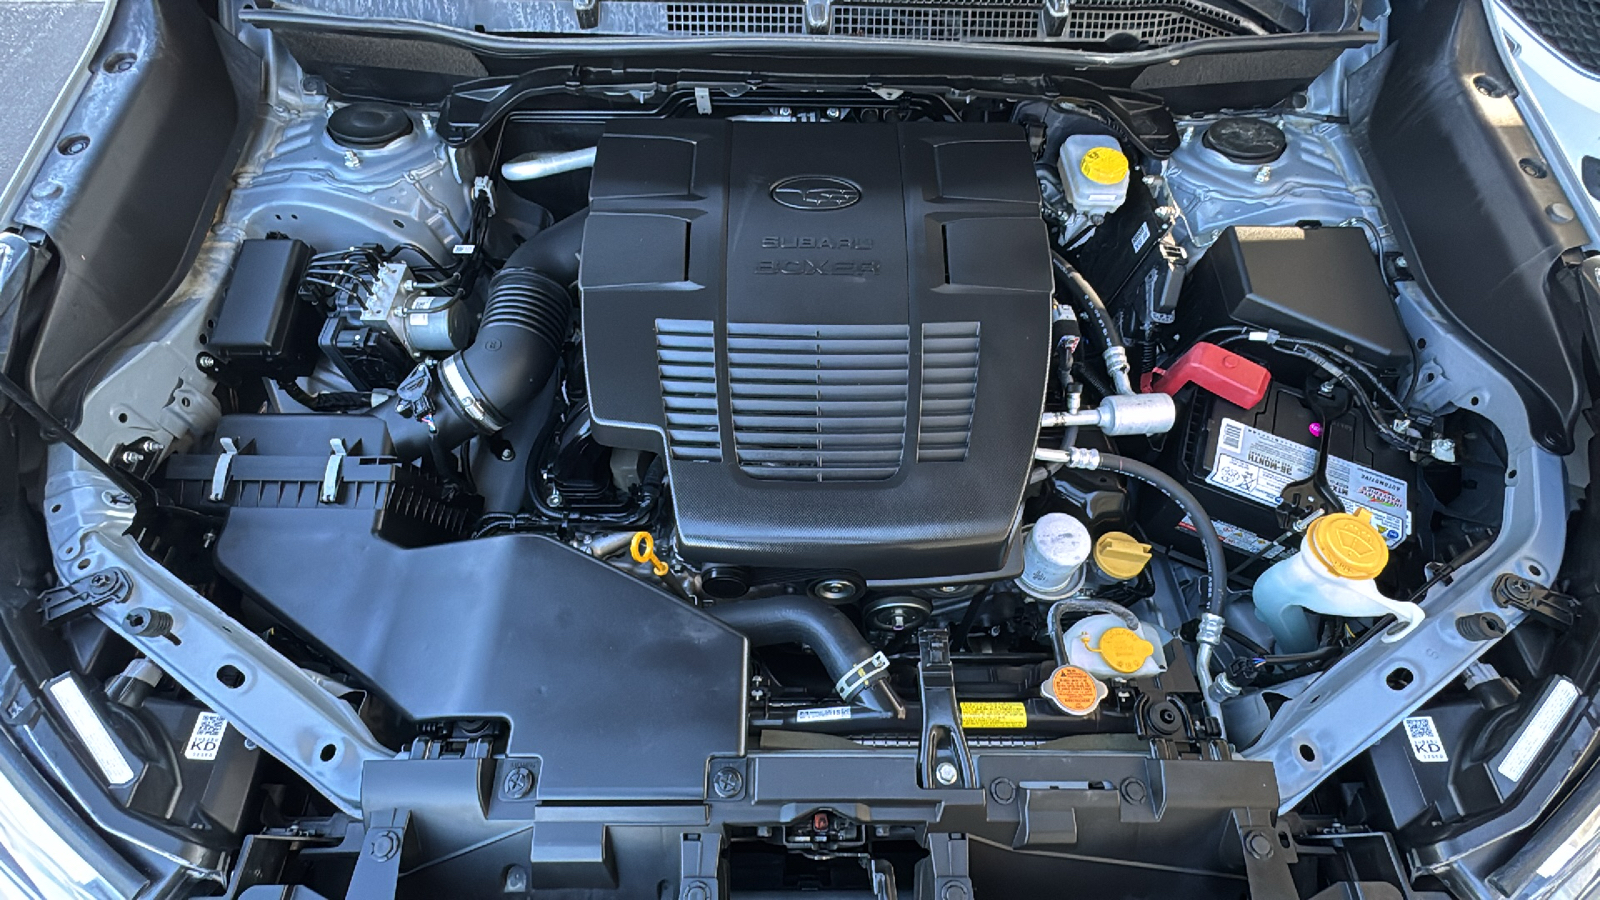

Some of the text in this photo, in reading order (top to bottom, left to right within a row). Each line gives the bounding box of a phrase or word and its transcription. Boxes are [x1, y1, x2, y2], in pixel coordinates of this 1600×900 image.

[761, 236, 873, 250] SUBARU
[754, 259, 881, 276] BOXER
[1361, 473, 1401, 491] AUTOMOTIVE
[190, 740, 216, 752] KD
[1416, 743, 1441, 754] KD
